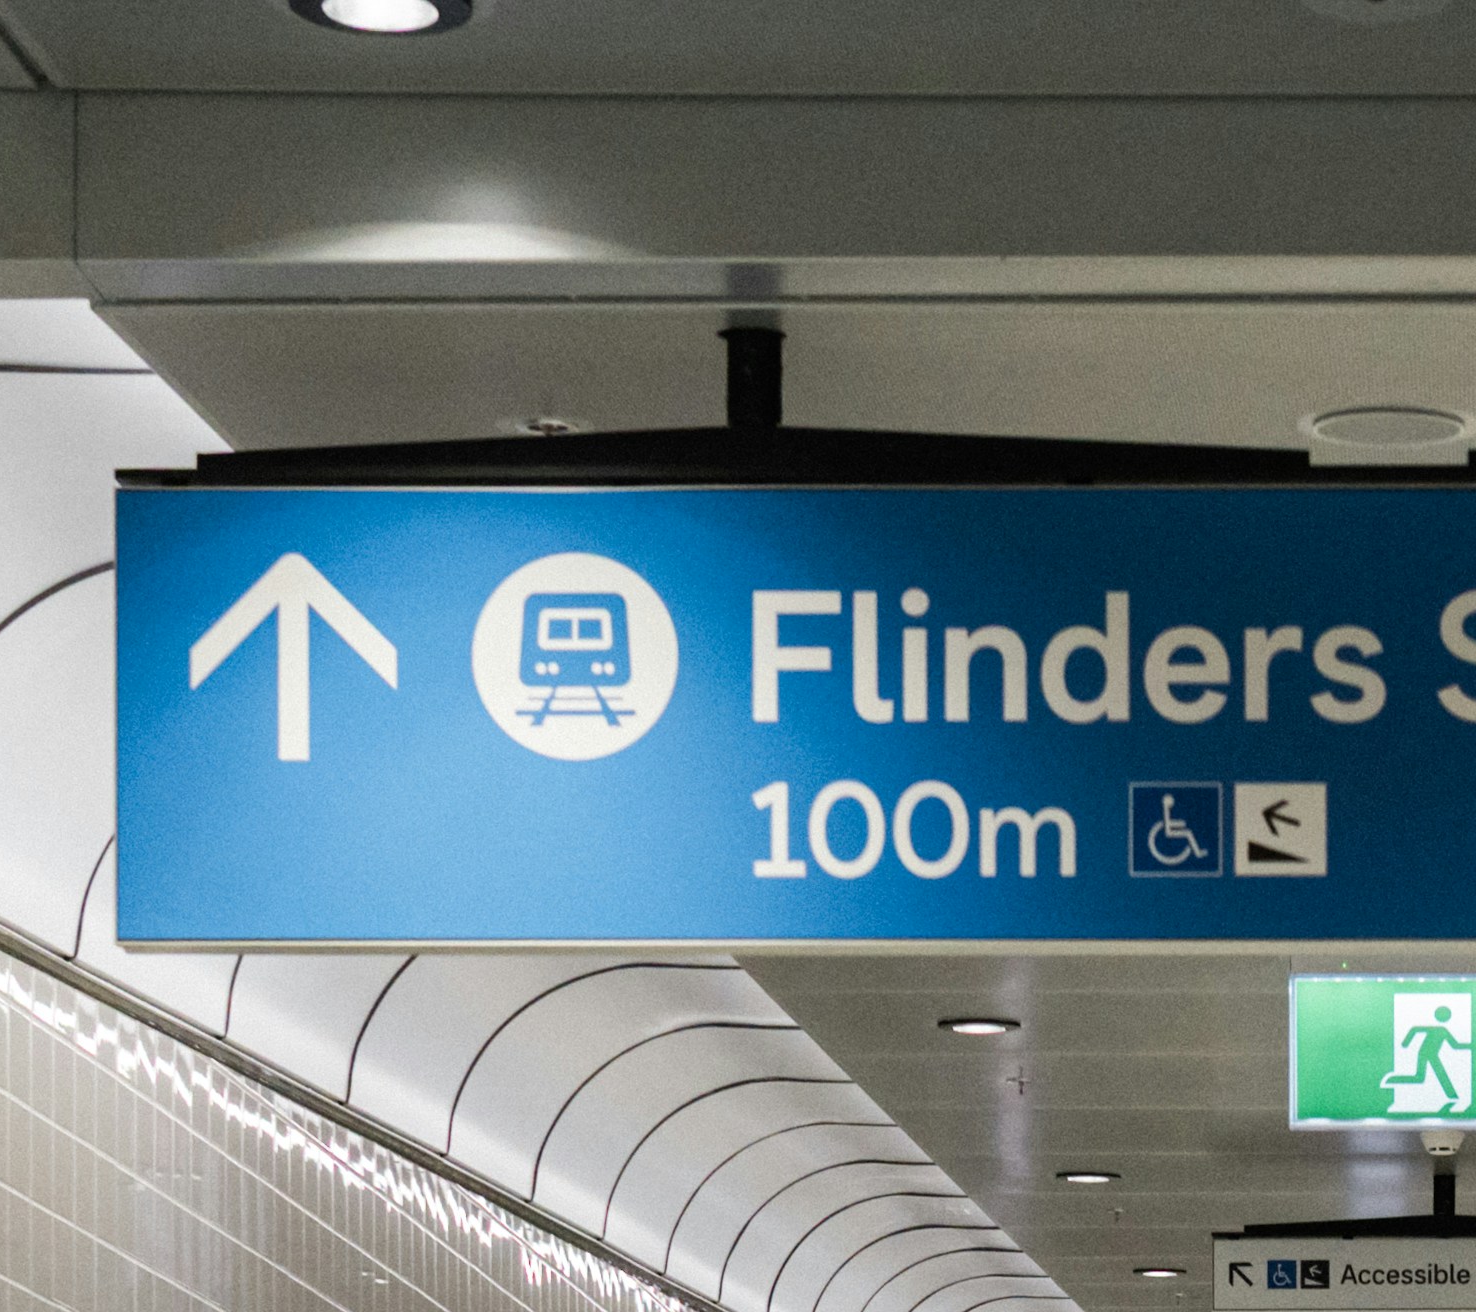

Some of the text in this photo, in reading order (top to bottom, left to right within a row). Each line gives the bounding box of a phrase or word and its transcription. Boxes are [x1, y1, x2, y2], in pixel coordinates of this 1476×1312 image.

[752, 588, 1385, 724] Flinders
[751, 780, 1076, 880] 100m
[1340, 1262, 1471, 1286] Accessible
